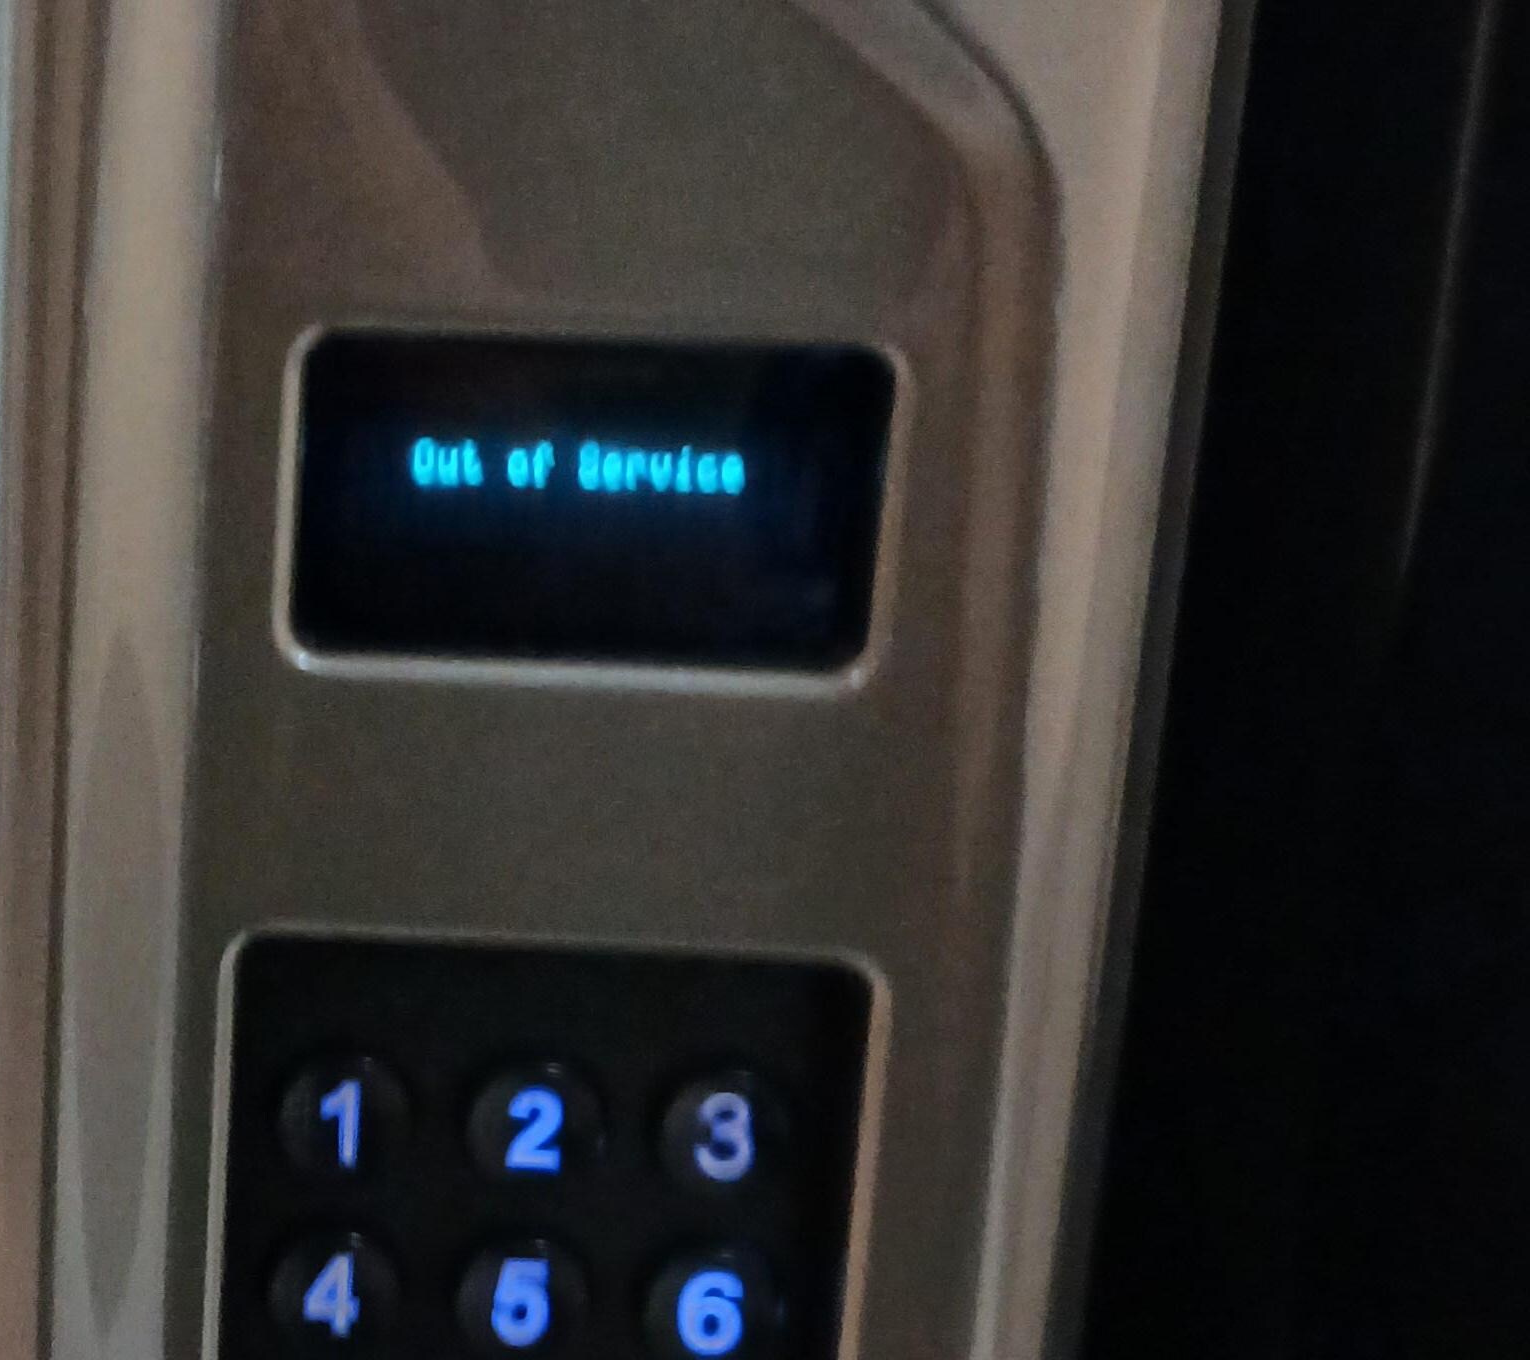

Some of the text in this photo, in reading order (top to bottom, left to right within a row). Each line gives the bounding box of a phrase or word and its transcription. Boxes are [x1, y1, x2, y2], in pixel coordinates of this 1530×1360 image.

[413, 437, 745, 495] Out of Service
[320, 1078, 755, 1182] 1 2 3
[303, 1251, 744, 1357] 4 5 6
